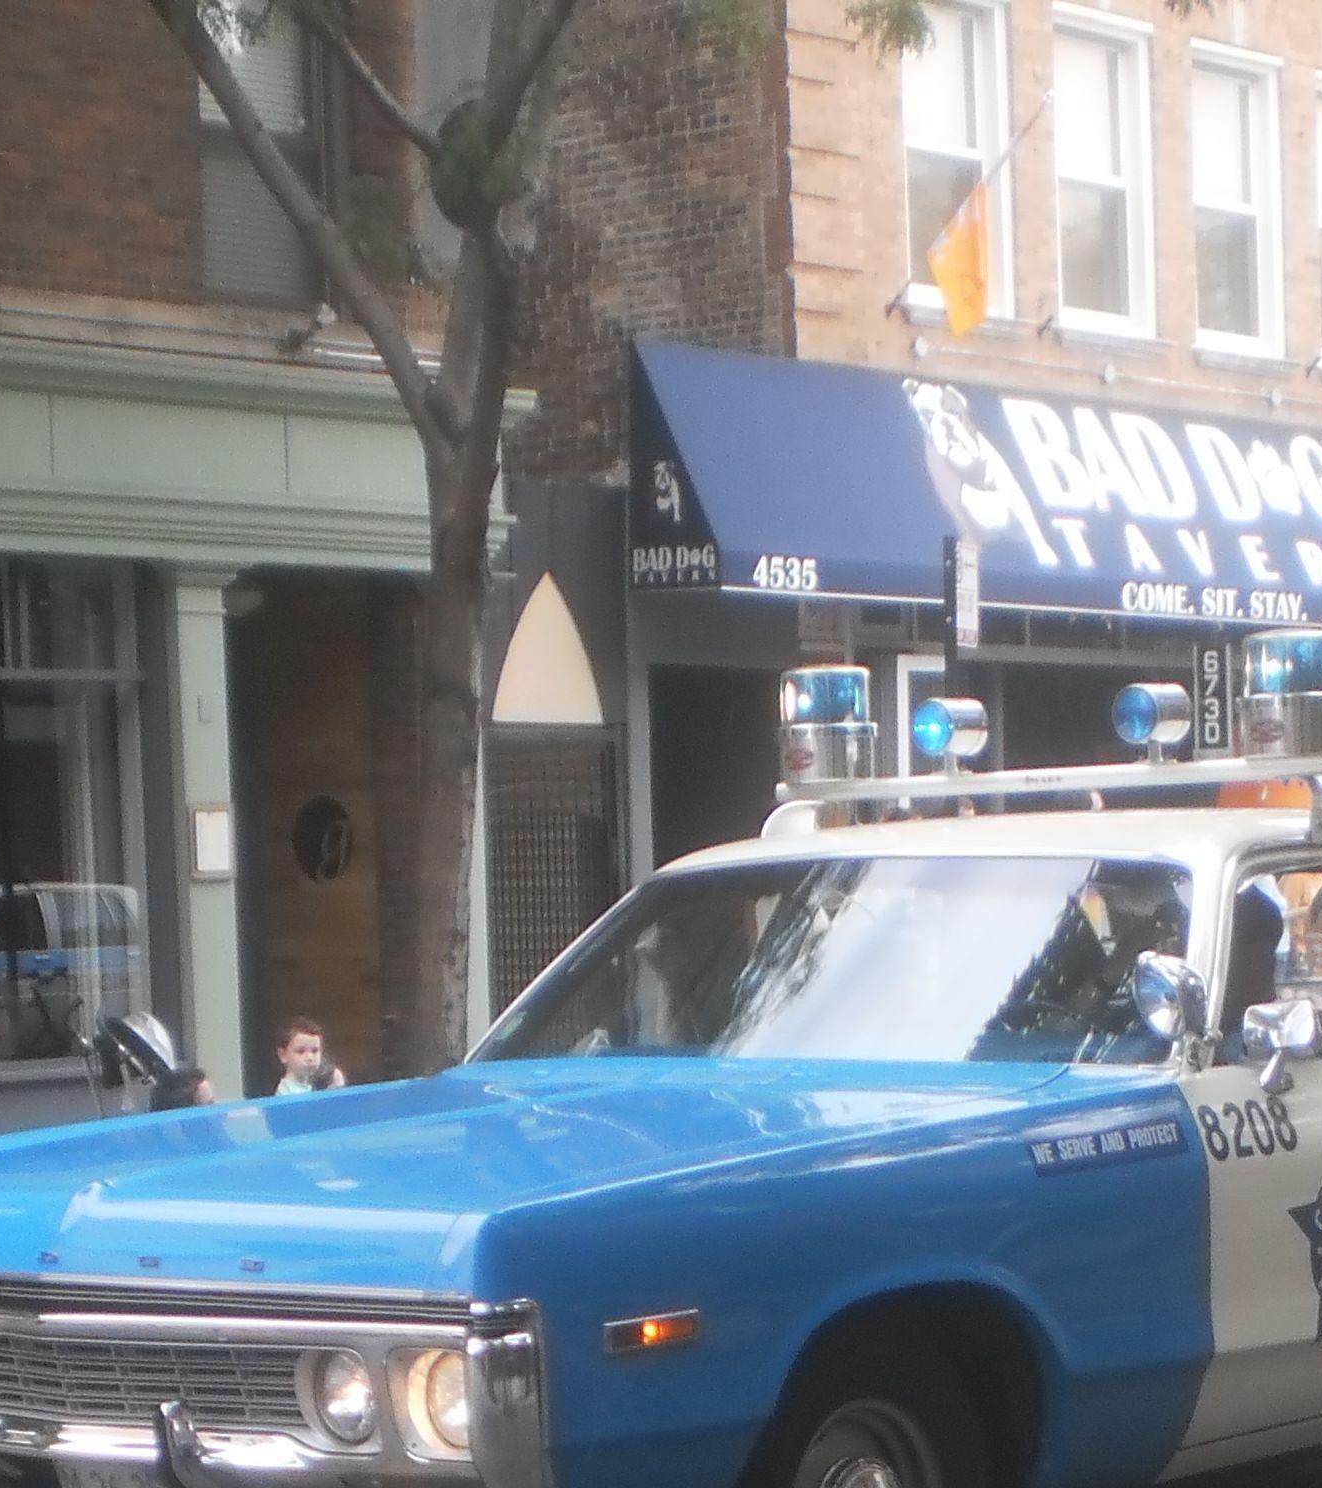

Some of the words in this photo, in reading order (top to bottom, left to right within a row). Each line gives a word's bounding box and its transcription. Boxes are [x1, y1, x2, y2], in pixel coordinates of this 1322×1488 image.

[1002, 399, 1196, 521] BAD
[633, 547, 672, 572] BAD
[753, 555, 817, 590] 4535
[1122, 582, 1194, 613] COME.
[1202, 588, 1243, 617] SIT.
[1250, 592, 1308, 621] STAY.
[1204, 650, 1219, 744] 6730
[1031, 1142, 1054, 1164] WE
[1057, 1136, 1097, 1161] SERVE
[1100, 1131, 1125, 1154] AND
[1128, 1123, 1178, 1149] PROTECT
[1198, 1096, 1298, 1161] 8208
